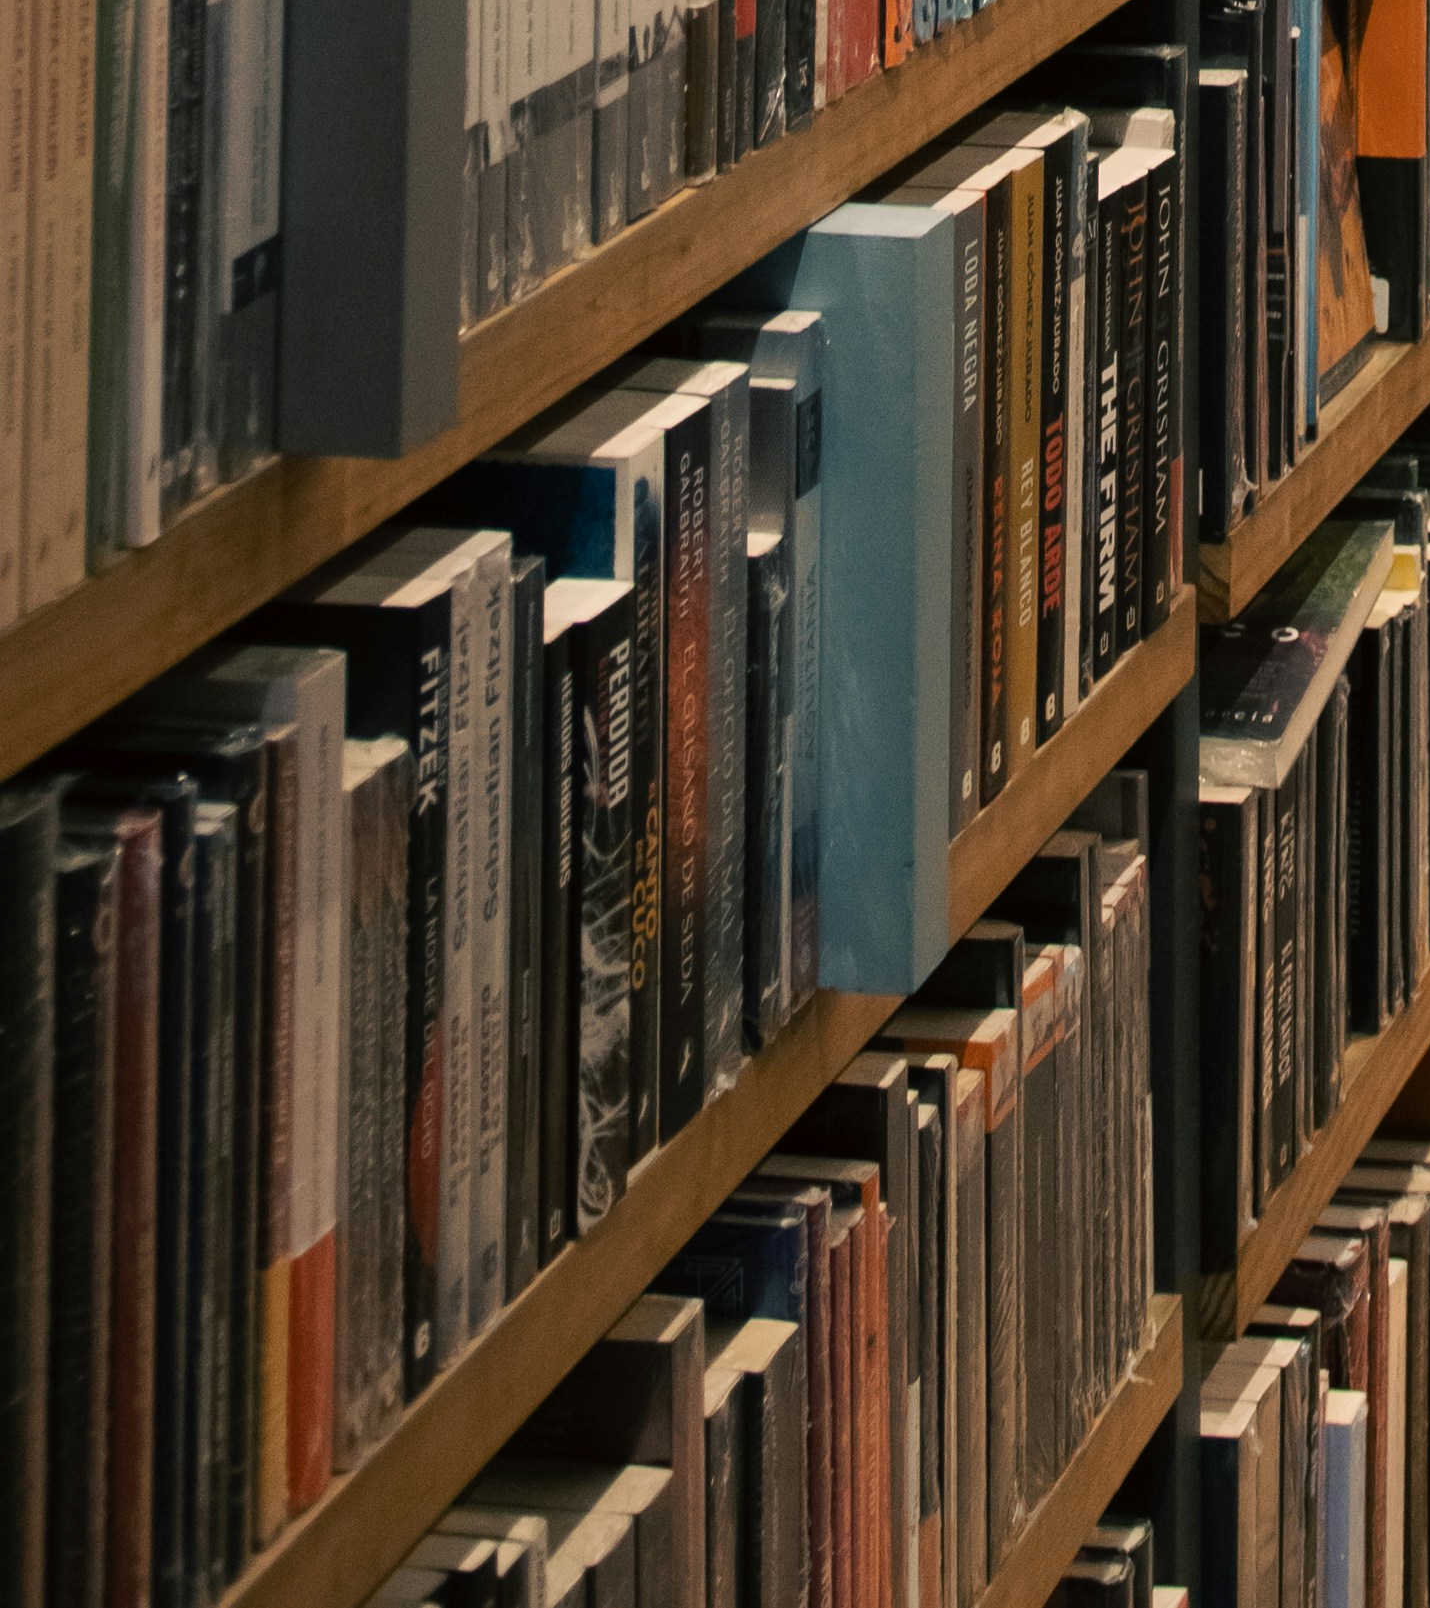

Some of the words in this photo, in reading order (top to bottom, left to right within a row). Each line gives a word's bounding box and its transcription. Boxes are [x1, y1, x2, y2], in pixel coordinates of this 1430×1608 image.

[1027, 194, 1035, 247] JUAN
[1054, 176, 1063, 227] JUAN
[1104, 221, 1113, 269] JOHN
[1157, 184, 1171, 299] JOHN
[964, 238, 978, 312] LOBA
[1050, 233, 1064, 395] GÓMEZ-JURADO
[1104, 271, 1112, 353] GRISHAM
[1123, 202, 1146, 327] JOHN
[963, 318, 978, 414] NEGRA
[996, 284, 1004, 446] GÓMEZ-JURADO
[1024, 252, 1036, 423] GÓMEZ-JURADO
[1043, 413, 1064, 512] TODO
[1099, 350, 1117, 464] THE
[1154, 340, 1170, 535] GRISHAM
[677, 452, 692, 619] GALBRAITH
[692, 465, 704, 583] ROBERT
[717, 419, 731, 584] GALBRAITH
[731, 434, 743, 548] ROBERT
[992, 475, 1003, 596] REINA
[1020, 458, 1034, 510] REY
[1123, 375, 1142, 594] GRISHAM
[1019, 517, 1033, 629] BLANCO
[1042, 523, 1061, 620] ARDE
[1098, 469, 1115, 616] FIRM
[483, 581, 502, 706] Fitzek
[682, 642, 697, 682] EL
[722, 608, 737, 651] EL
[992, 606, 1002, 710] ROJA
[416, 646, 440, 816] FITZEK
[560, 671, 574, 773] HERIDAS
[608, 638, 630, 809] PERDIDA
[679, 692, 696, 847] GUSANO
[720, 657, 735, 780] OFICIO
[482, 717, 504, 918] Sebastian
[559, 775, 572, 889] ABIERTAS
[645, 805, 658, 940] CANTO
[720, 790, 734, 855] DEL
[425, 877, 438, 913] LA
[632, 879, 647, 991] CUCO
[679, 857, 693, 907] DE
[423, 919, 436, 1016] NOCHE
[678, 919, 694, 1007] SEDA
[422, 1021, 435, 1079] DEL
[420, 1083, 435, 1159] OCHO
